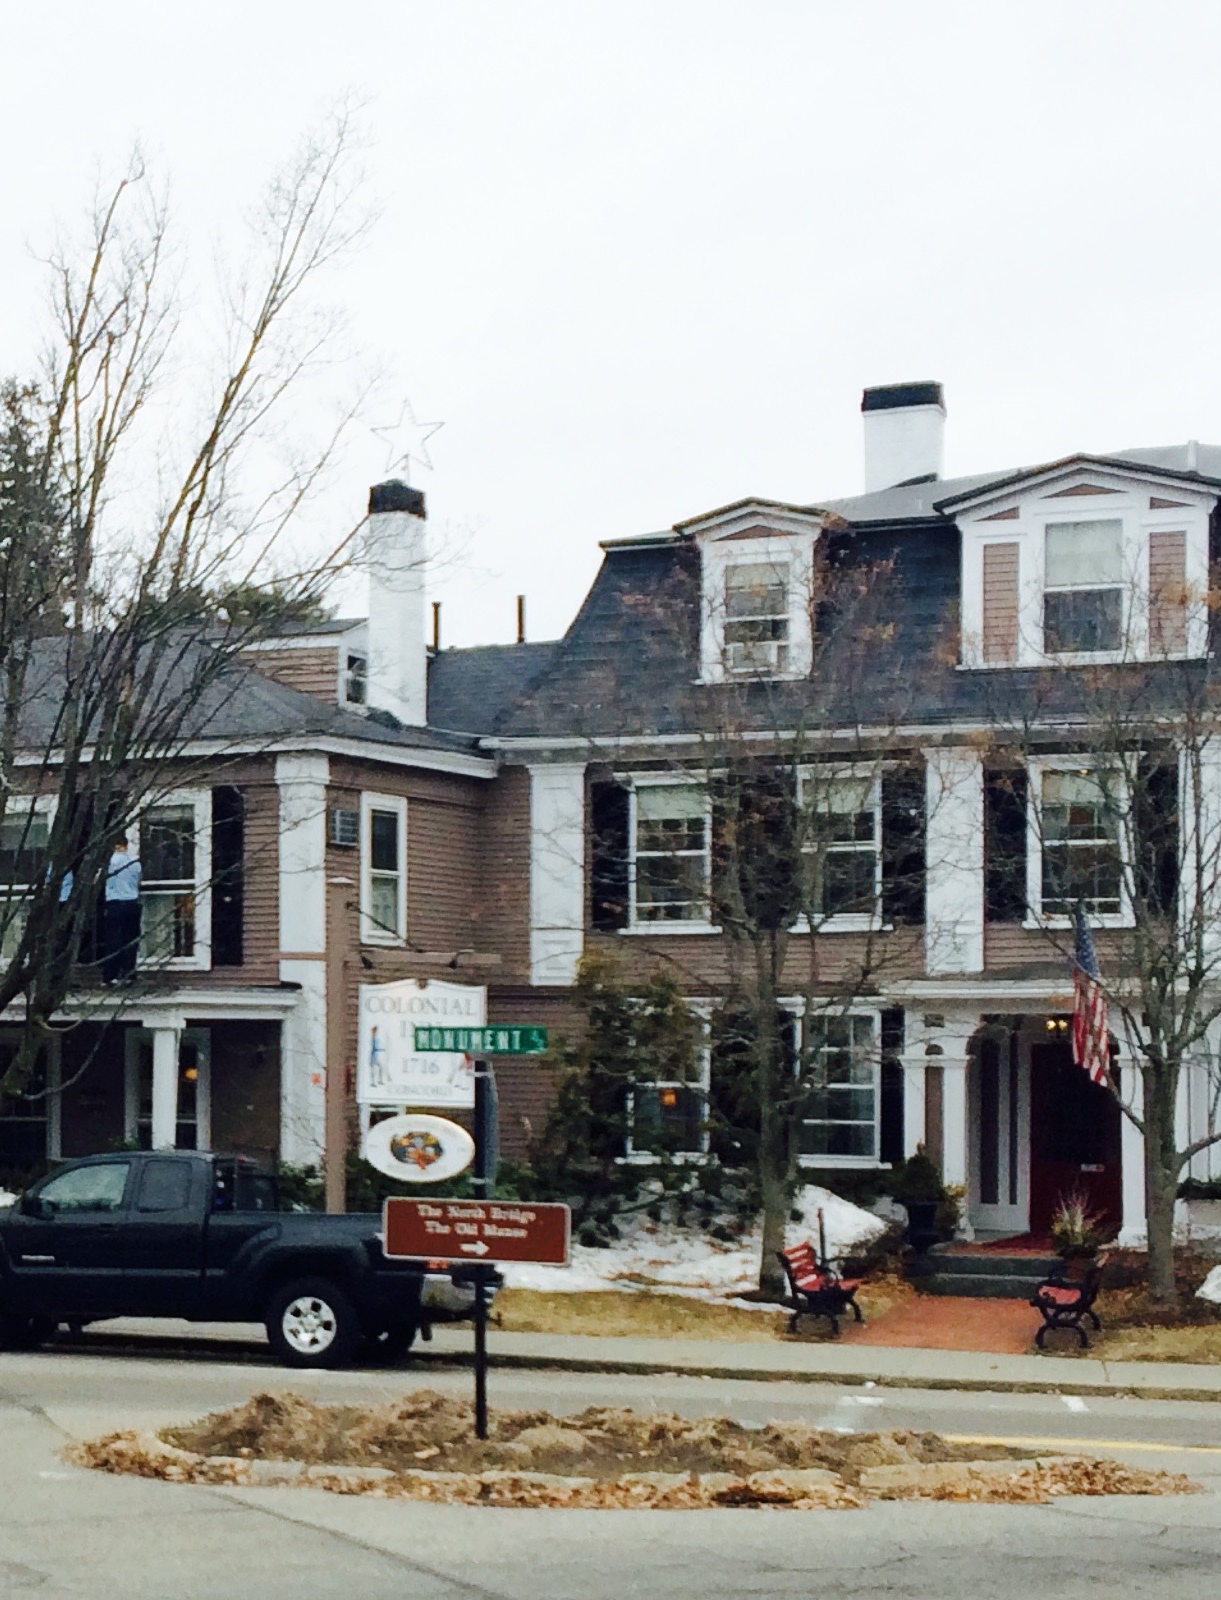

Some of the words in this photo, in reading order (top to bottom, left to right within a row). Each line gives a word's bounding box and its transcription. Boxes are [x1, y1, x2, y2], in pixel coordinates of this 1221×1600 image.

[365, 996, 478, 1017] COLONIAL
[417, 1029, 521, 1050] MONUMENT
[401, 1057, 441, 1075] 1716
[417, 1204, 444, 1217] The
[447, 1204, 486, 1219] North
[490, 1207, 536, 1224] Bridge
[424, 1220, 451, 1234] The
[454, 1222, 479, 1236] Old
